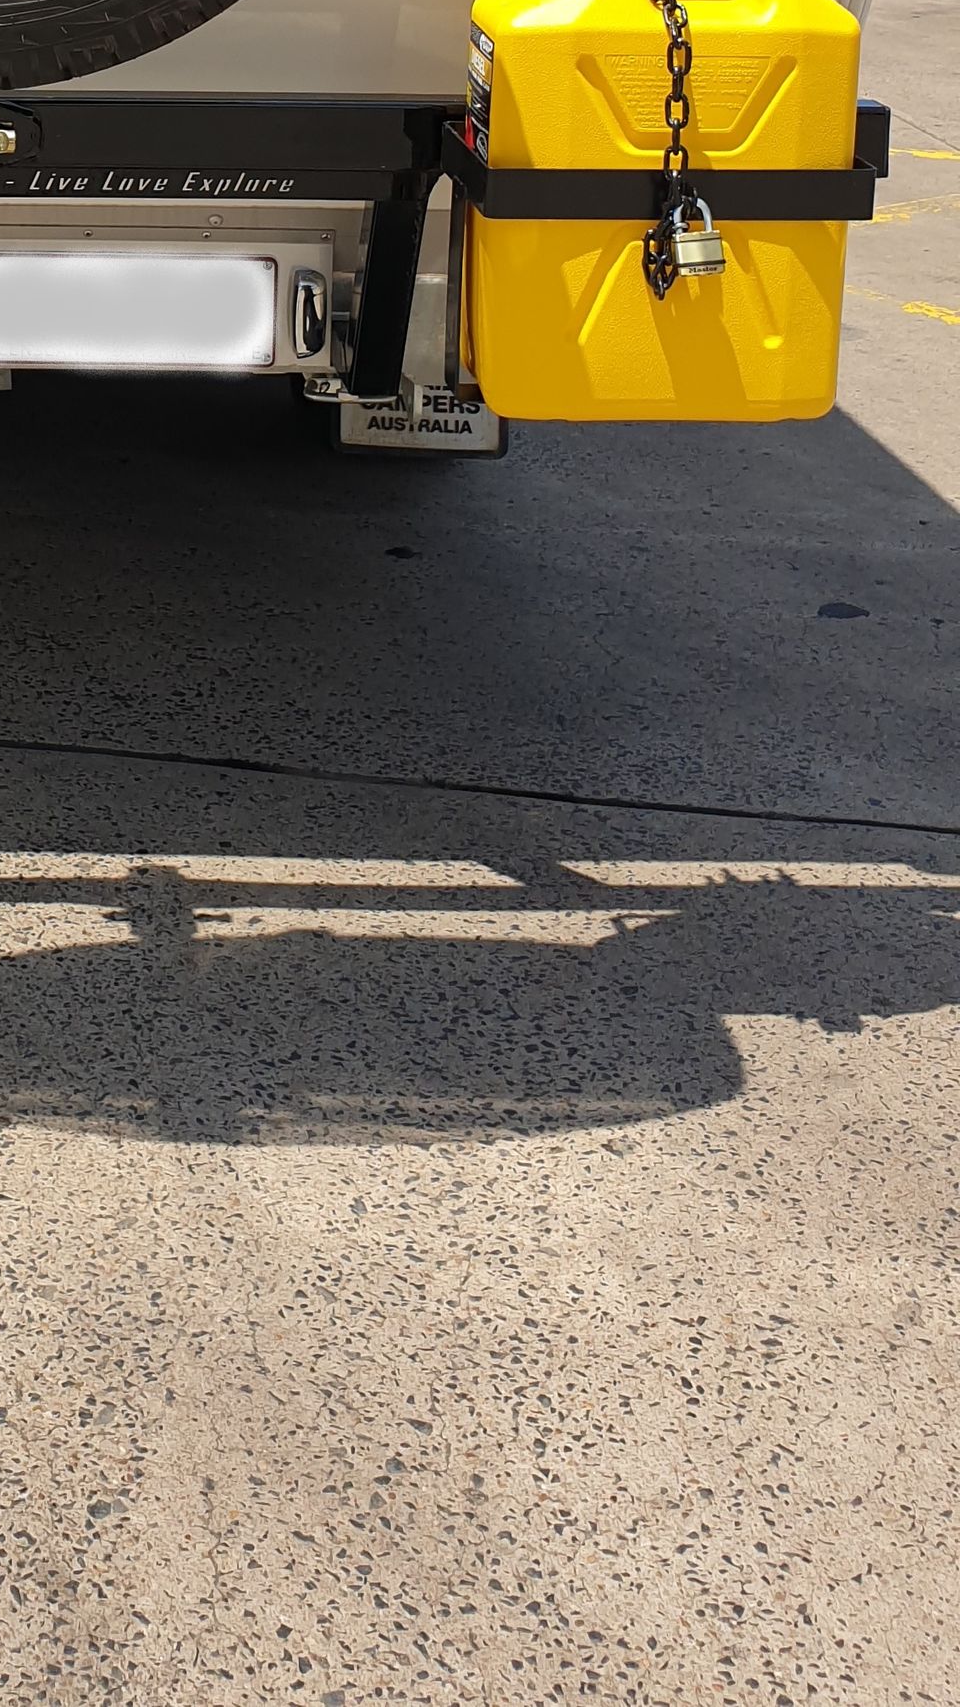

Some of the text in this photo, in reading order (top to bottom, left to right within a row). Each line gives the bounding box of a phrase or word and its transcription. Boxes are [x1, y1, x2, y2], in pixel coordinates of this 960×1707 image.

[29, 170, 88, 191] Live
[102, 171, 169, 191] Love
[182, 172, 295, 195] Explore
